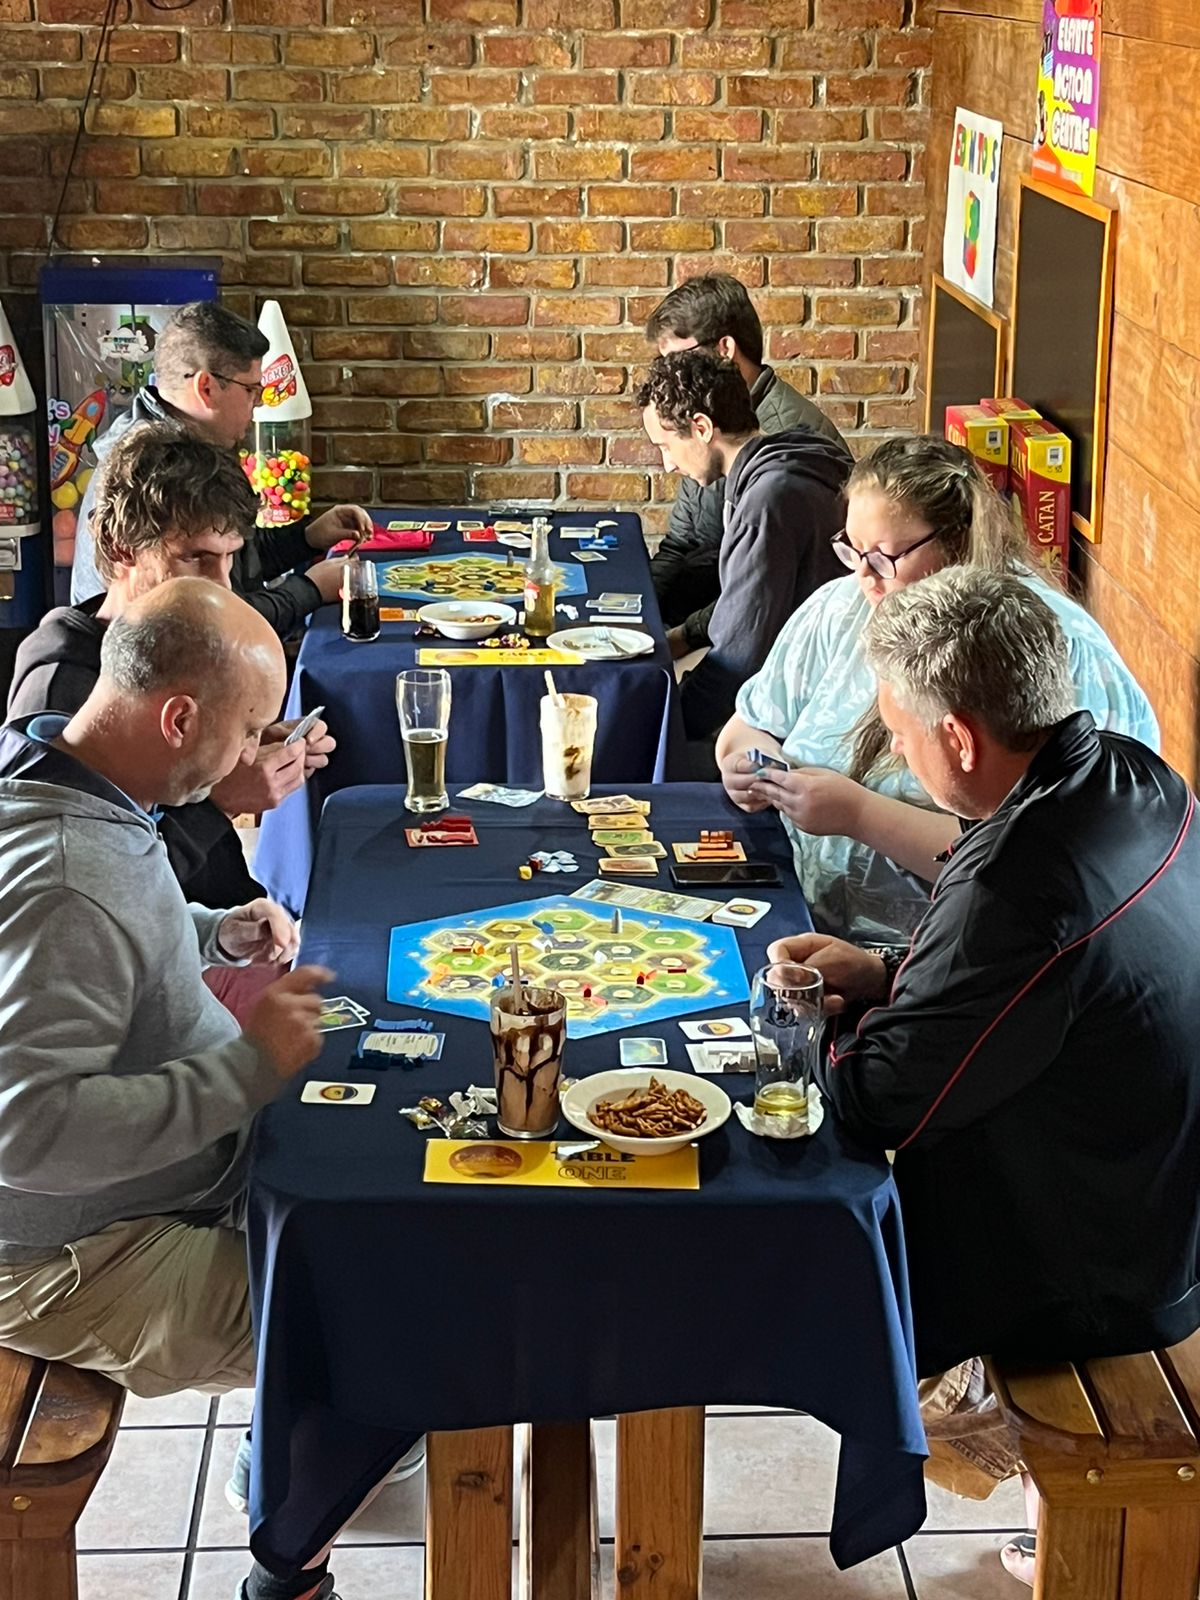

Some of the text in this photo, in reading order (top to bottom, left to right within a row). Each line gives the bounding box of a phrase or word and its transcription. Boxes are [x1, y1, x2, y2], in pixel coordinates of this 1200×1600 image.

[1053, 63, 1093, 105] ACTION
[1051, 107, 1090, 155] CENTRE
[1036, 491, 1055, 543] CATAN
[557, 1164, 627, 1181] ONE
